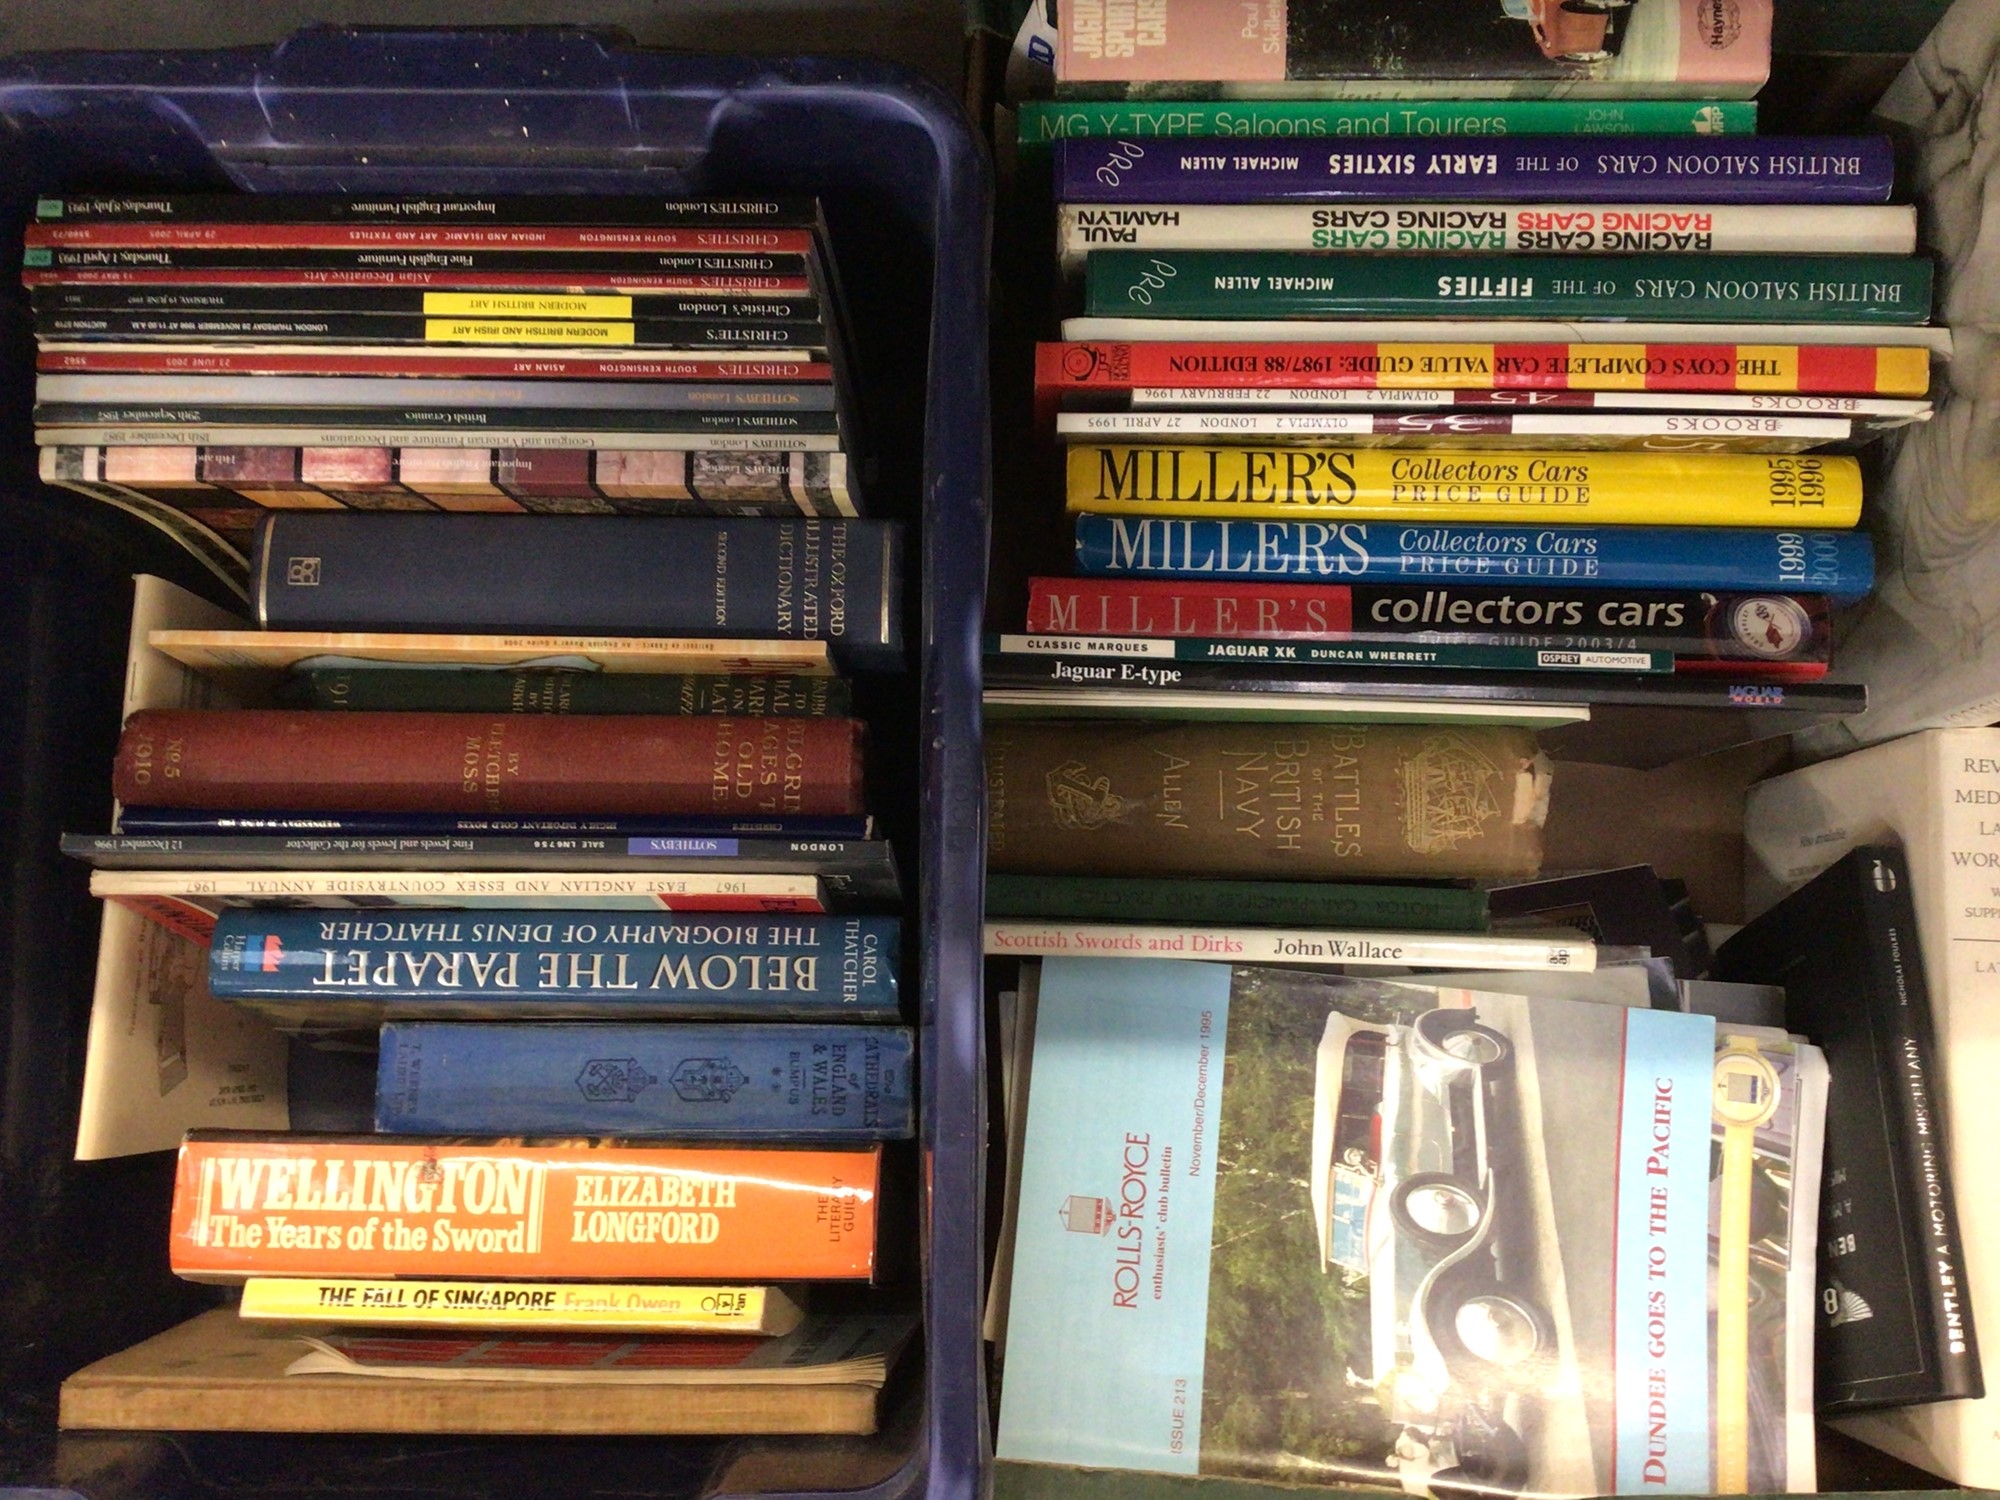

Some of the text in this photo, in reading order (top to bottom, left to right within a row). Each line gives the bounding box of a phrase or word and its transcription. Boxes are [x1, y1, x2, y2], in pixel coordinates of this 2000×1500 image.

[1041, 111, 1507, 138] MG Y-TYPE Saloons and Tourers
[1180, 154, 1861, 175] BRITISH SALOON CARS OF THE EARLY SIXTIES MICHAEL ALLEN
[351, 200, 778, 214] CHRISTIE'S London Important English Furniture
[1078, 211, 1179, 226] HAMLYN
[350, 231, 778, 245] CHRISTIE'S SOUTH KENSINGTON INDIAN AND ISLAMIC ART AND TEXTILES
[1078, 227, 1137, 242] PAUL
[1312, 230, 1712, 250] RACING CARS RACING CARS
[470, 300, 728, 314] London MODERN BRITISH ART
[453, 326, 788, 341] CHRISTIE'S MODERN BRITISH AND IRISH ART
[1169, 356, 1781, 375] THE COYS COMPLETE CAR VALUE GUIDE: 1987/88 EDITION
[1088, 417, 1778, 431] BROOKS OLYMPIA 2 LONDON 27 APRIL 1995
[1095, 449, 1356, 505] MILLER'S
[1392, 457, 1589, 482] Collectors Cars
[1770, 459, 1796, 508] 1995
[1799, 459, 1825, 508] 1996
[1392, 486, 1590, 504] PRICE GUIDE
[1106, 518, 1369, 576] MILLER'S
[1399, 529, 1598, 554] Collectors Cars
[1779, 533, 1805, 582] 1999
[778, 524, 793, 634] DICTIONARY
[804, 520, 820, 639] ILLUSTRATED
[1400, 556, 1599, 576] PRICE GUIDE
[831, 563, 846, 636] OXFORD
[1046, 591, 1685, 634] MILLER'S collectors cars
[1027, 640, 1646, 665] CLASSIC MARQUES JAGUAR XK DUNCAN WHERRETT OSPREY AUTOMOTIVE
[1052, 661, 1182, 682] Jaguar E-type
[463, 735, 480, 792] MOSS
[1155, 750, 1190, 829] ALLEN
[1222, 750, 1268, 838] NAVY
[1270, 740, 1310, 849] BRITISH
[1330, 734, 1366, 857] BATTLES
[246, 879, 745, 893] 1967 EAST ANGLIAN AND ESSEX COUNTRYSIDE ANNUAL
[320, 922, 820, 946] THE BIOGRAPHY OF DENIS THATCHER
[995, 931, 1402, 960] Scottish Swords and Dirks John Wallace
[313, 949, 819, 991] BELOW THE PARAPET
[843, 919, 860, 1002] THATCHER
[862, 934, 878, 986] CAROL
[811, 1060, 827, 1115] WALES
[831, 1044, 846, 1116] ENGLAND
[864, 1036, 879, 1127] CATHEDRALS
[1188, 1010, 1213, 1177] November/December 1995
[218, 1158, 528, 1215] WELLINGTON
[574, 1175, 736, 1208] ELIZABETH
[1918, 1140, 1944, 1237] MOTORING
[211, 1216, 525, 1253] The Years of the Sword
[571, 1211, 720, 1243] LONGFORD
[1113, 1132, 1151, 1309] ROLLS-ROYCE
[1151, 1146, 1173, 1301] enthusiasts' club bulletin
[1938, 1244, 1953, 1258] A
[319, 1287, 681, 1312] THE FALL OF SINGAPORE Frank Owen
[1643, 1077, 1674, 1486] DUNDEE GOES TO THE PACIFIC
[1936, 1262, 1966, 1354] BENTLEY
[1171, 1378, 1187, 1455] ISSUE 213
